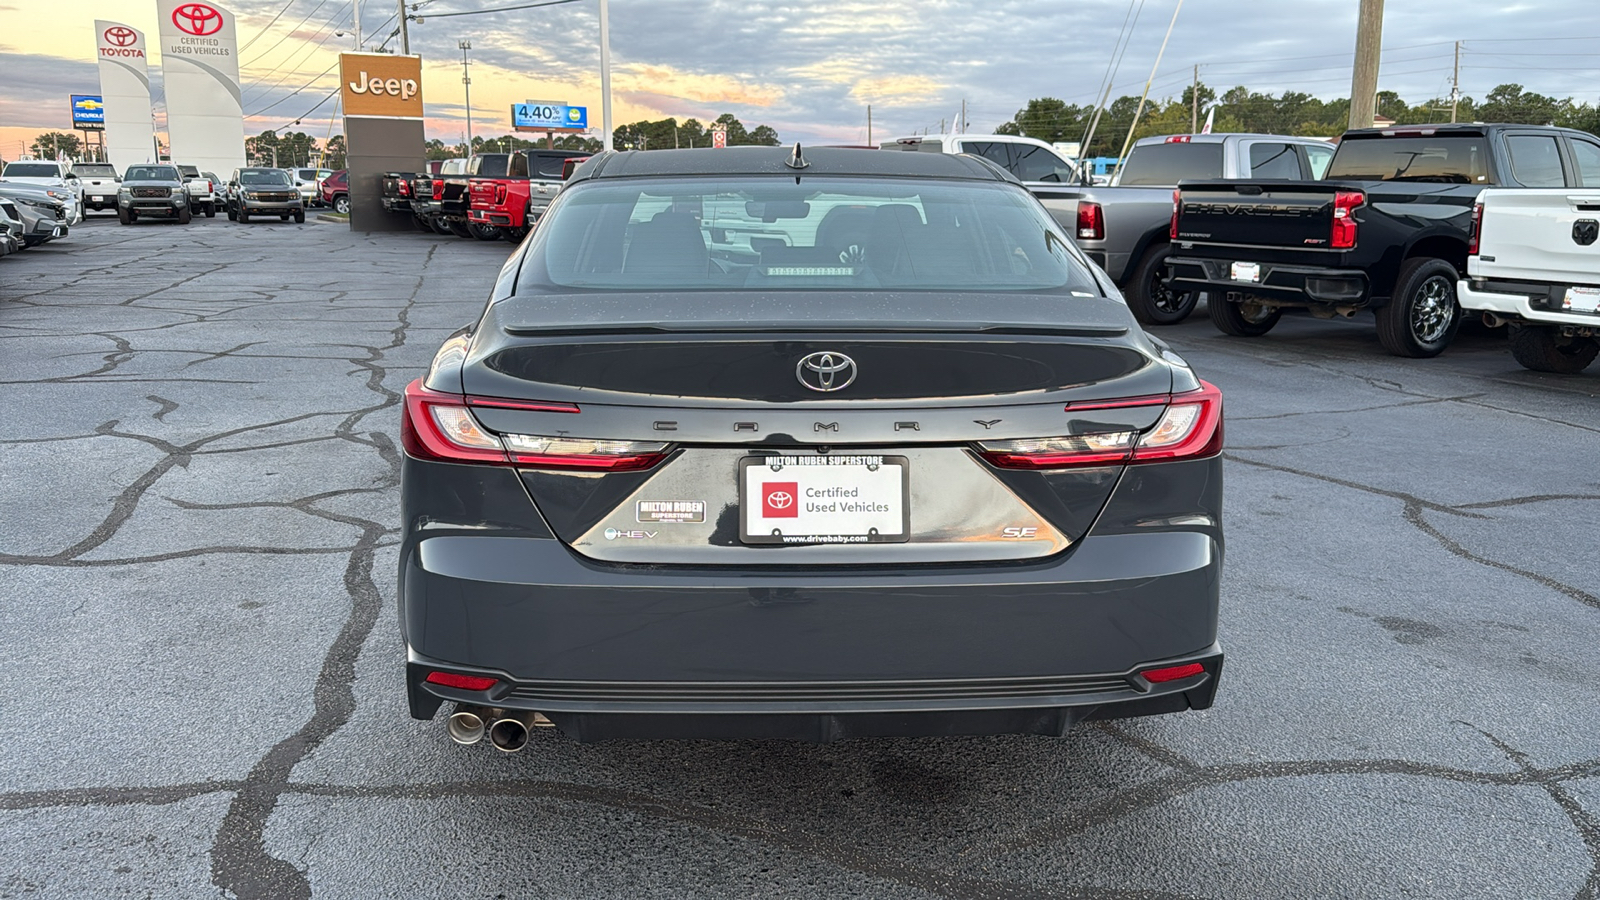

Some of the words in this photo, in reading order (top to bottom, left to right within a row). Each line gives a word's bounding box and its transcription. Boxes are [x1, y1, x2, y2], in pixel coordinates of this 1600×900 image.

[180, 37, 219, 46] CERTIFIED
[99, 47, 145, 58] TOYOTA
[171, 45, 192, 54] USED
[194, 46, 230, 56] VEHICLES
[349, 71, 418, 100] Jeep
[652, 419, 1003, 433] CAMRY
[765, 456, 797, 466] MILTON
[799, 456, 827, 466] RUBEN
[828, 456, 884, 466] SUPERSTORE
[805, 487, 859, 498] Certified
[640, 501, 673, 512] MILTON
[674, 501, 703, 512] RUBEN
[805, 502, 836, 513] Used
[840, 502, 889, 513] Vehicles
[617, 530, 658, 539] HEV
[1001, 527, 1038, 538] SE
[783, 535, 868, 544] www.drivebaby.com
